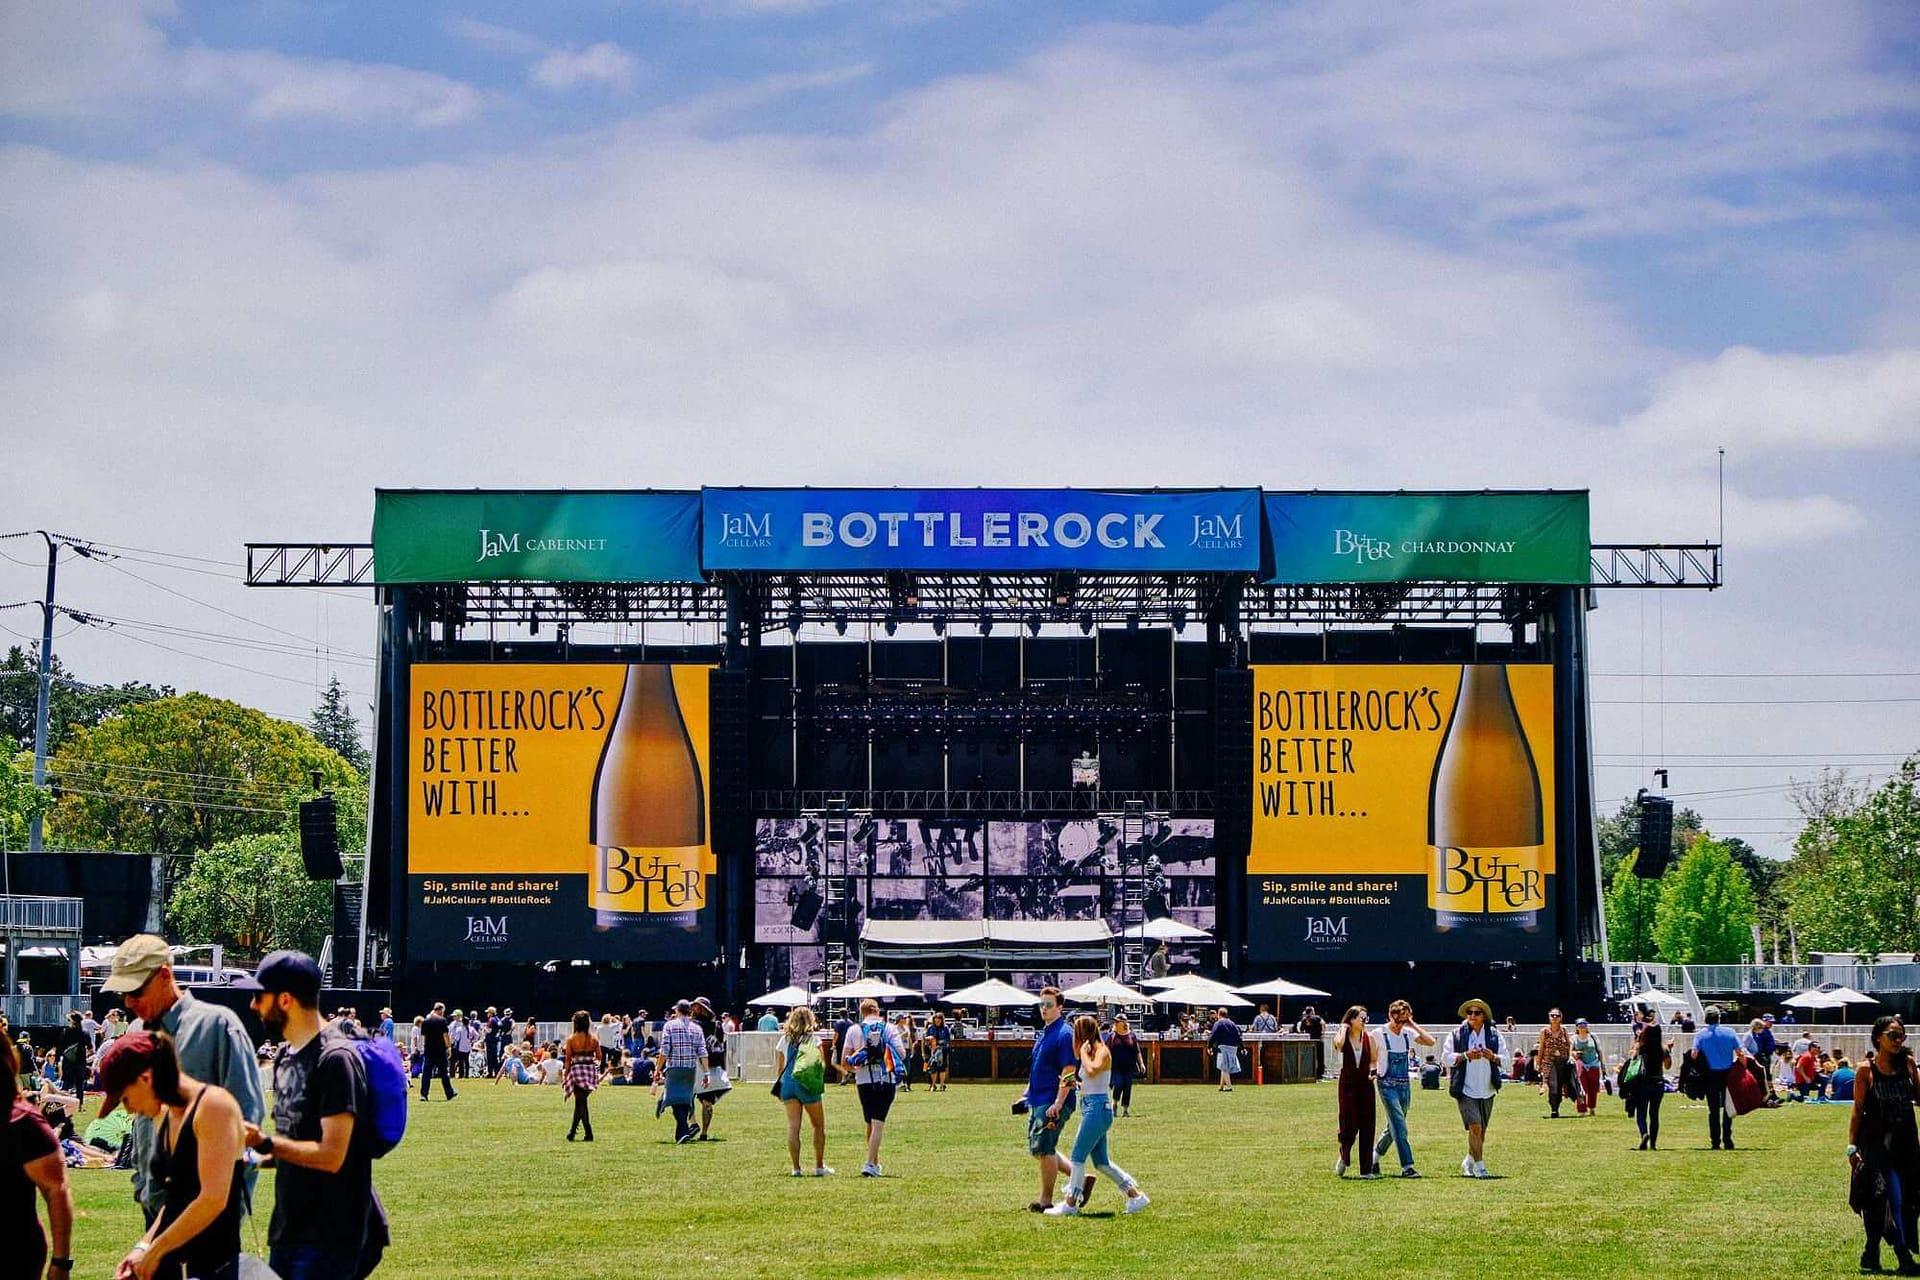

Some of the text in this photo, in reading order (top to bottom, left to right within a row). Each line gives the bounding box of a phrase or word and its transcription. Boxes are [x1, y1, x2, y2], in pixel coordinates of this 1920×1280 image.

[719, 513, 772, 544] JaM
[802, 512, 1165, 548] BOTTLEROCK
[1190, 513, 1243, 546] JaM
[477, 529, 607, 562] JaM CABERNET
[726, 538, 772, 547] CELLARS
[1197, 540, 1243, 549] CELLARS
[1401, 541, 1516, 553] CHARDONNAY
[422, 738, 519, 774] BETTER
[1259, 738, 1355, 774] BETTER
[422, 780, 530, 817] WITH...
[1260, 780, 1368, 817] WITH...
[423, 880, 559, 892] Sip, smile and share!
[1262, 881, 1398, 893] Sip, smile and share!
[423, 896, 551, 904] #JaMCellars #BottleRock
[1263, 896, 1391, 905] #JaMCellars #BottleRock
[463, 917, 508, 941] JaM
[1303, 917, 1348, 941] JaM
